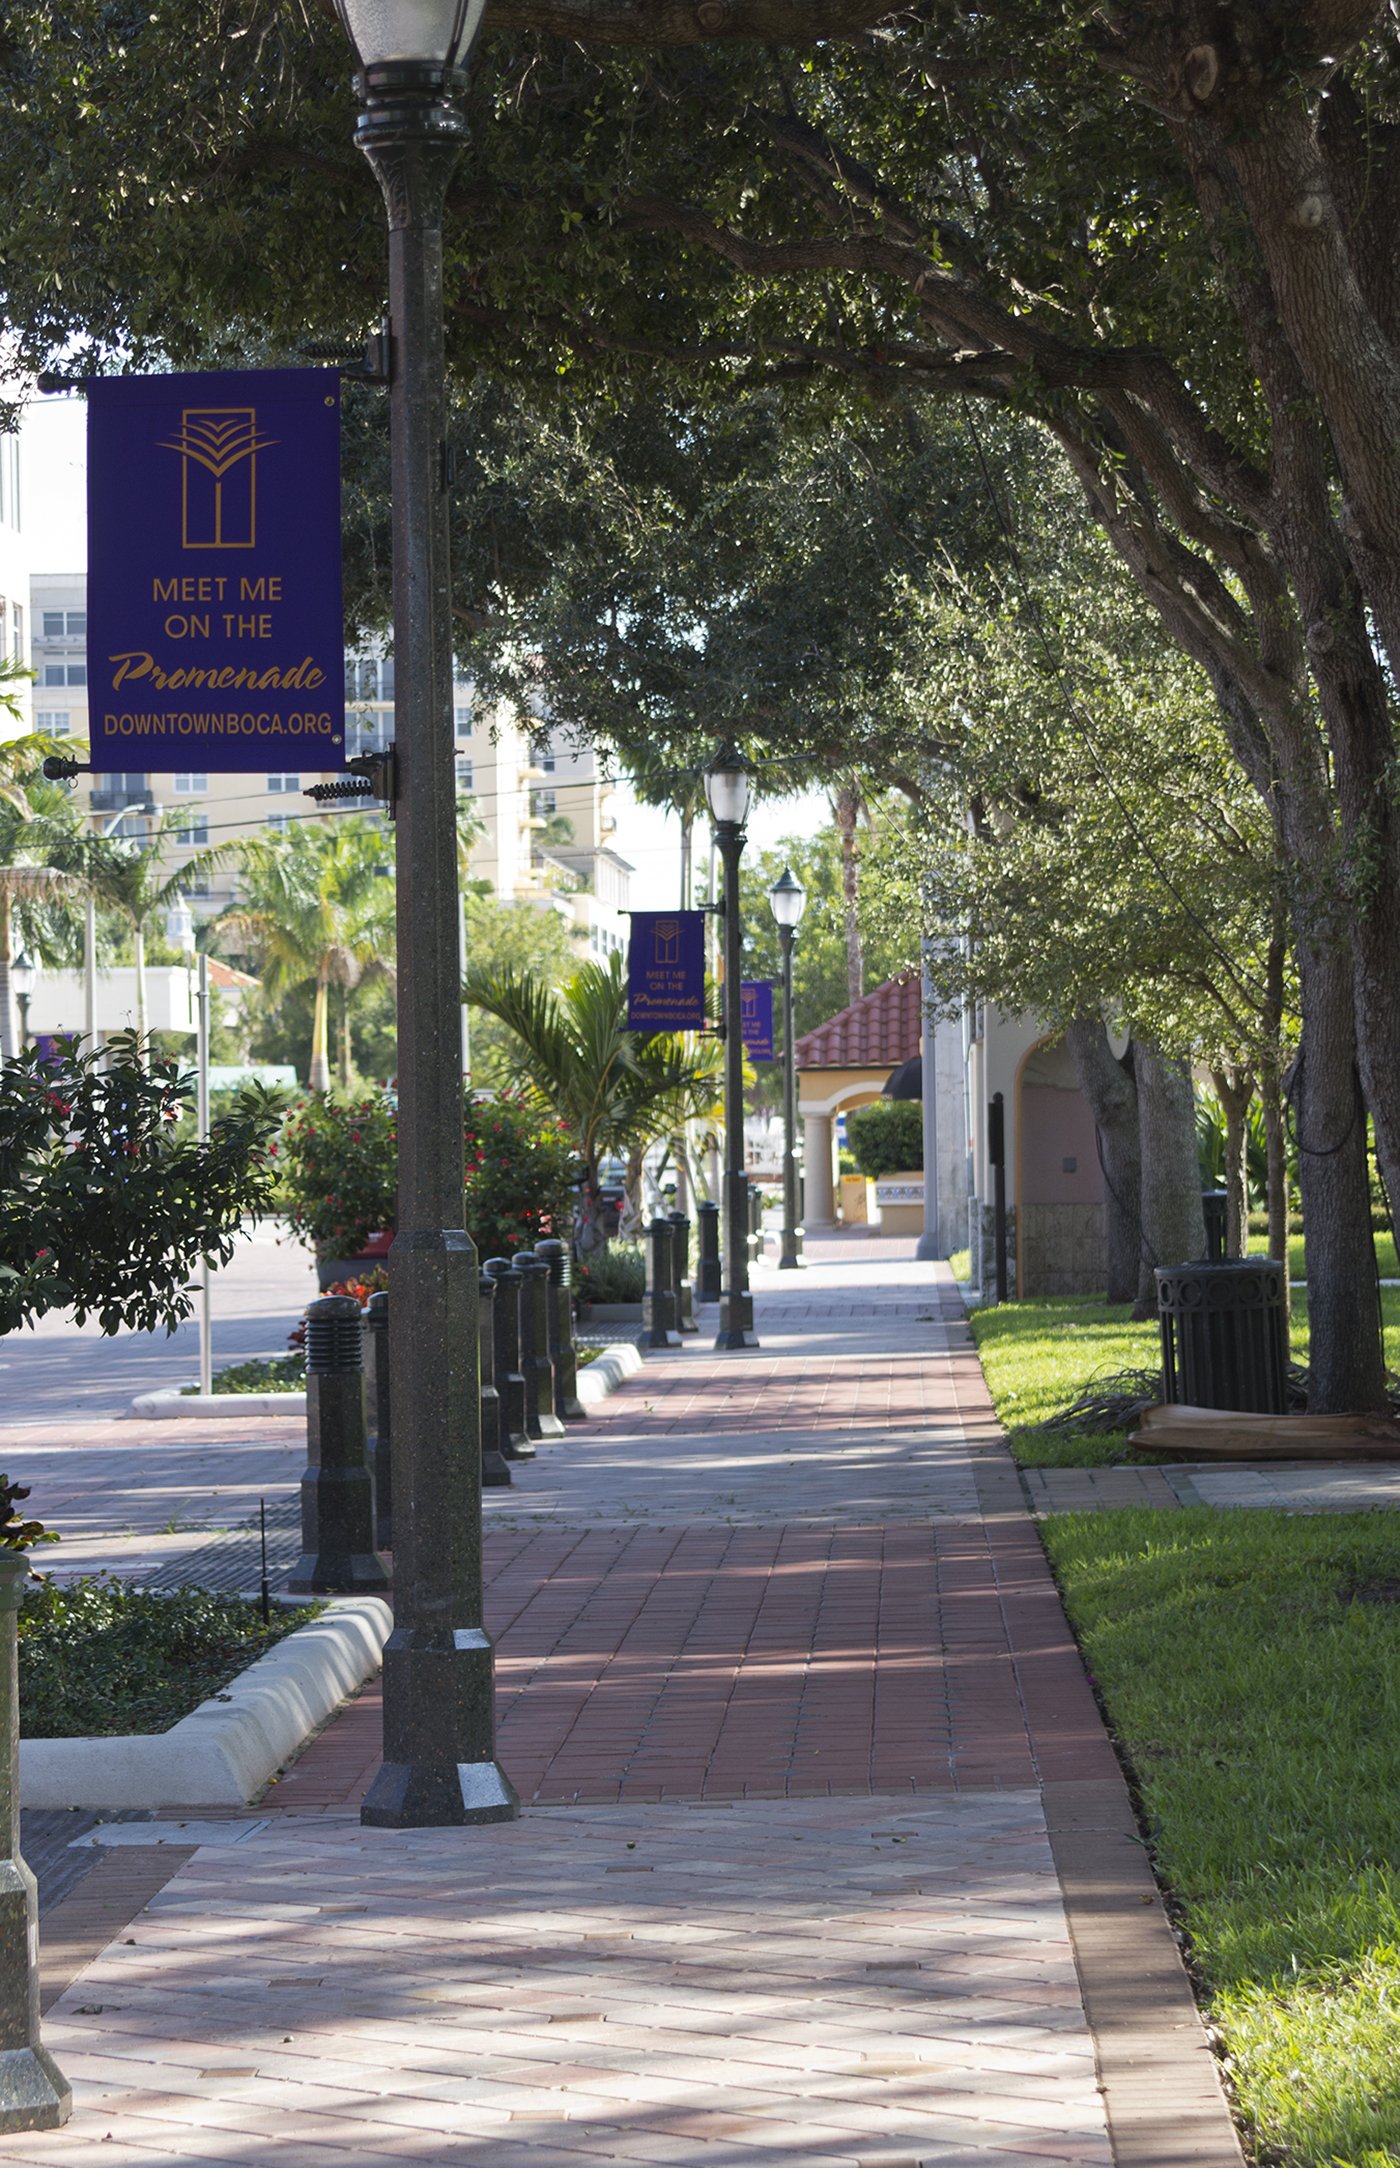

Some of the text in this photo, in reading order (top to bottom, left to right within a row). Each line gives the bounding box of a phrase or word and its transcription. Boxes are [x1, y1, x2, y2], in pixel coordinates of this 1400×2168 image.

[153, 577, 282, 601] MEET ME
[164, 614, 272, 639] ON THE
[108, 651, 327, 692] Promenade
[104, 713, 332, 735] DOWNTOWNBOCA.ORG
[646, 970, 686, 979] MEET ME
[649, 981, 683, 991] ON THE
[633, 993, 699, 1006] Promenade
